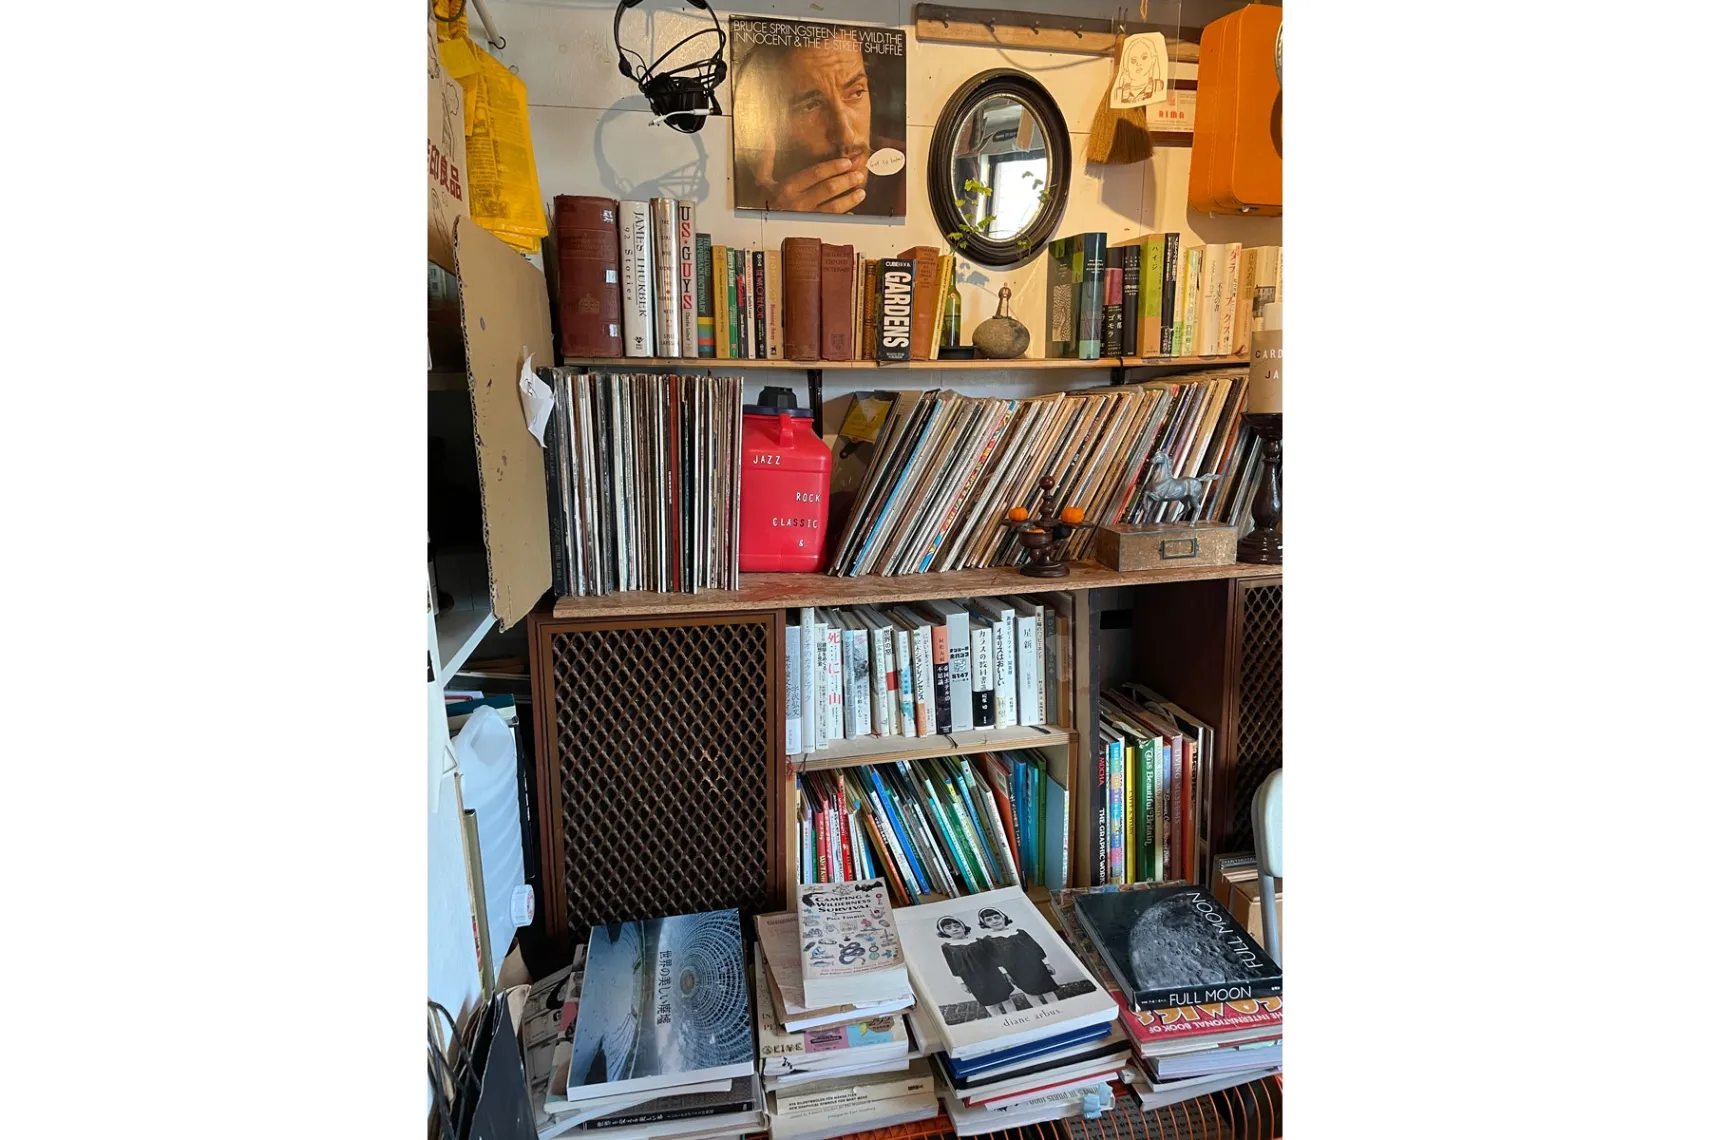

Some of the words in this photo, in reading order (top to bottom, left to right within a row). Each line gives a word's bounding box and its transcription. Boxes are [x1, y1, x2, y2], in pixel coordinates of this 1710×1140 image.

[734, 20, 767, 33] BRUCE
[840, 29, 857, 41] THE
[886, 34, 903, 47] THE
[734, 32, 792, 47] INNOCENT
[793, 37, 801, 47] &
[802, 37, 821, 49] THE
[833, 40, 863, 52] STREET
[864, 43, 903, 56] SHUFFLE
[427, 138, 463, 201] 印良品
[632, 210, 645, 252] JAMES
[624, 249, 634, 302] Stories
[636, 257, 648, 318] THURBER
[882, 271, 912, 348] GARDENS
[753, 455, 782, 466] JAZZ
[796, 492, 821, 503] ROCK
[772, 517, 819, 529] CLASSIC
[798, 539, 804, 547] &
[1023, 628, 1033, 655] 星新一
[996, 628, 1005, 687] イギリスはおいしい
[1146, 770, 1154, 811] Beautiful
[1145, 813, 1154, 848] Britain
[815, 895, 862, 903] CAMPING
[815, 898, 871, 908] WILDERNESS
[818, 903, 871, 913] SURVIVAL
[1186, 892, 1234, 934] MOON
[1228, 936, 1263, 968] FULL
[1169, 991, 1202, 1006] FULL
[1205, 985, 1252, 1002] MOON
[1149, 1025, 1164, 1034] OF
[1164, 1023, 1192, 1032] BOOK
[1192, 1013, 1271, 1028] INTERNATIONAL
